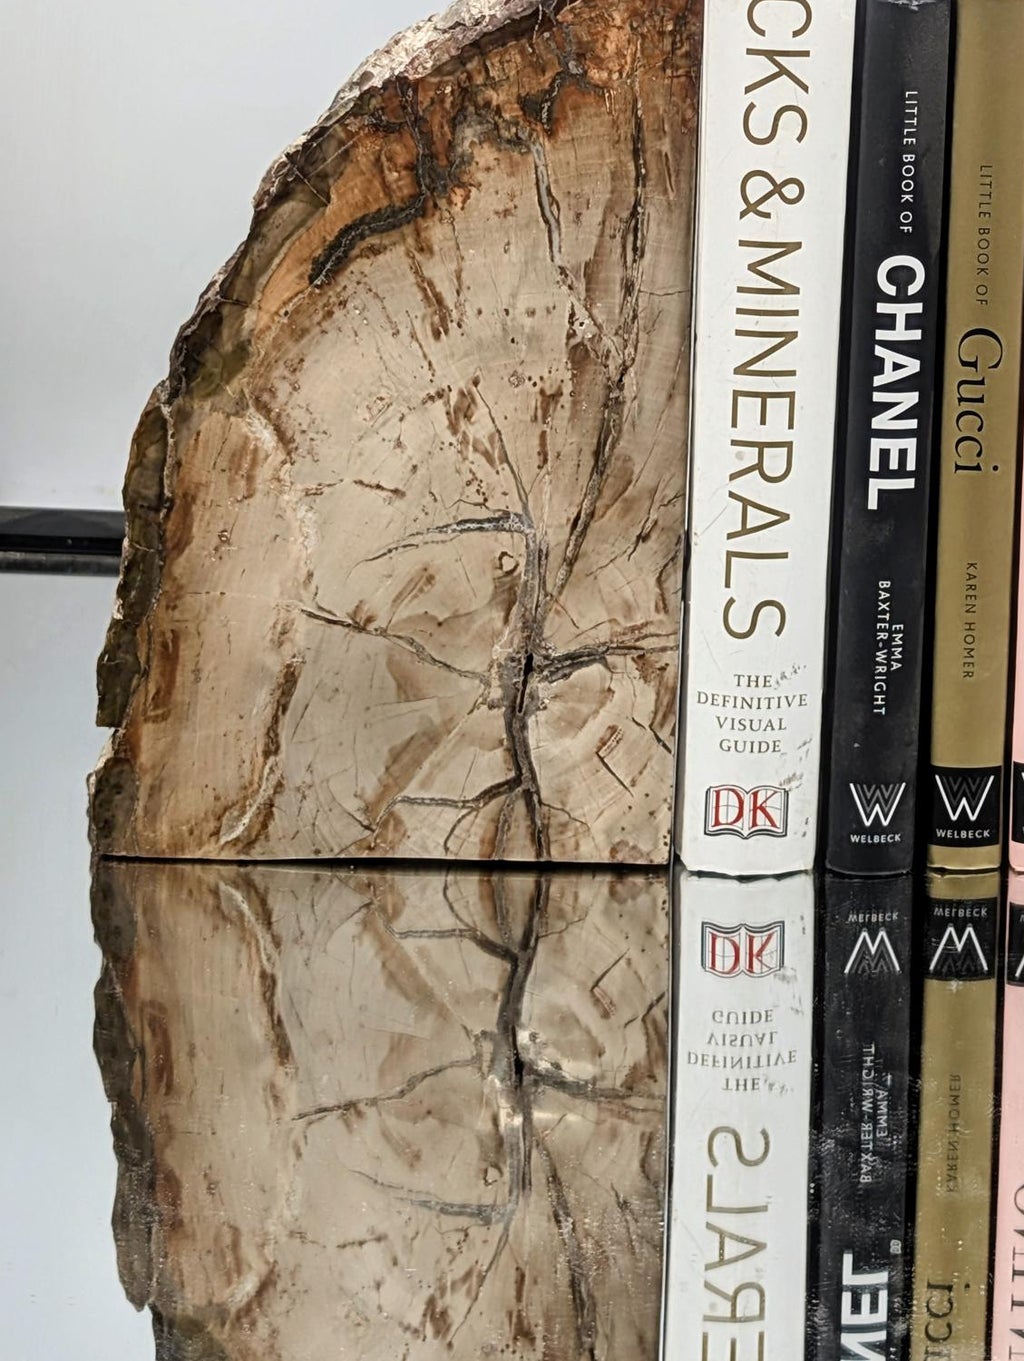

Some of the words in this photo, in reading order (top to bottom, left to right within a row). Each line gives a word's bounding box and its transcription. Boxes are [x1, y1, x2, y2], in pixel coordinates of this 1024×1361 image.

[903, 91, 919, 145] LITTLE
[739, 169, 805, 220] &
[900, 154, 916, 203] BOOK
[978, 164, 993, 219] LITTLE
[899, 211, 913, 233] OF
[976, 227, 991, 276] BOOK
[975, 284, 989, 306] OF
[867, 254, 926, 510] CHANEL
[954, 327, 1003, 474] Gucci
[722, 239, 803, 640] MINERALS
[964, 562, 978, 614] KAREN
[873, 580, 892, 715] BAXTER-WRIGHT
[890, 624, 904, 671] EMMA
[962, 621, 977, 678] HOMER
[697, 691, 808, 710] DEFINITIVE
[733, 674, 772, 689] THE
[716, 715, 787, 732] VISUAL
[719, 738, 781, 754] GUIDE
[713, 788, 777, 829] DK
[850, 833, 901, 844] WELBECK
[935, 828, 990, 839] WELBECK
